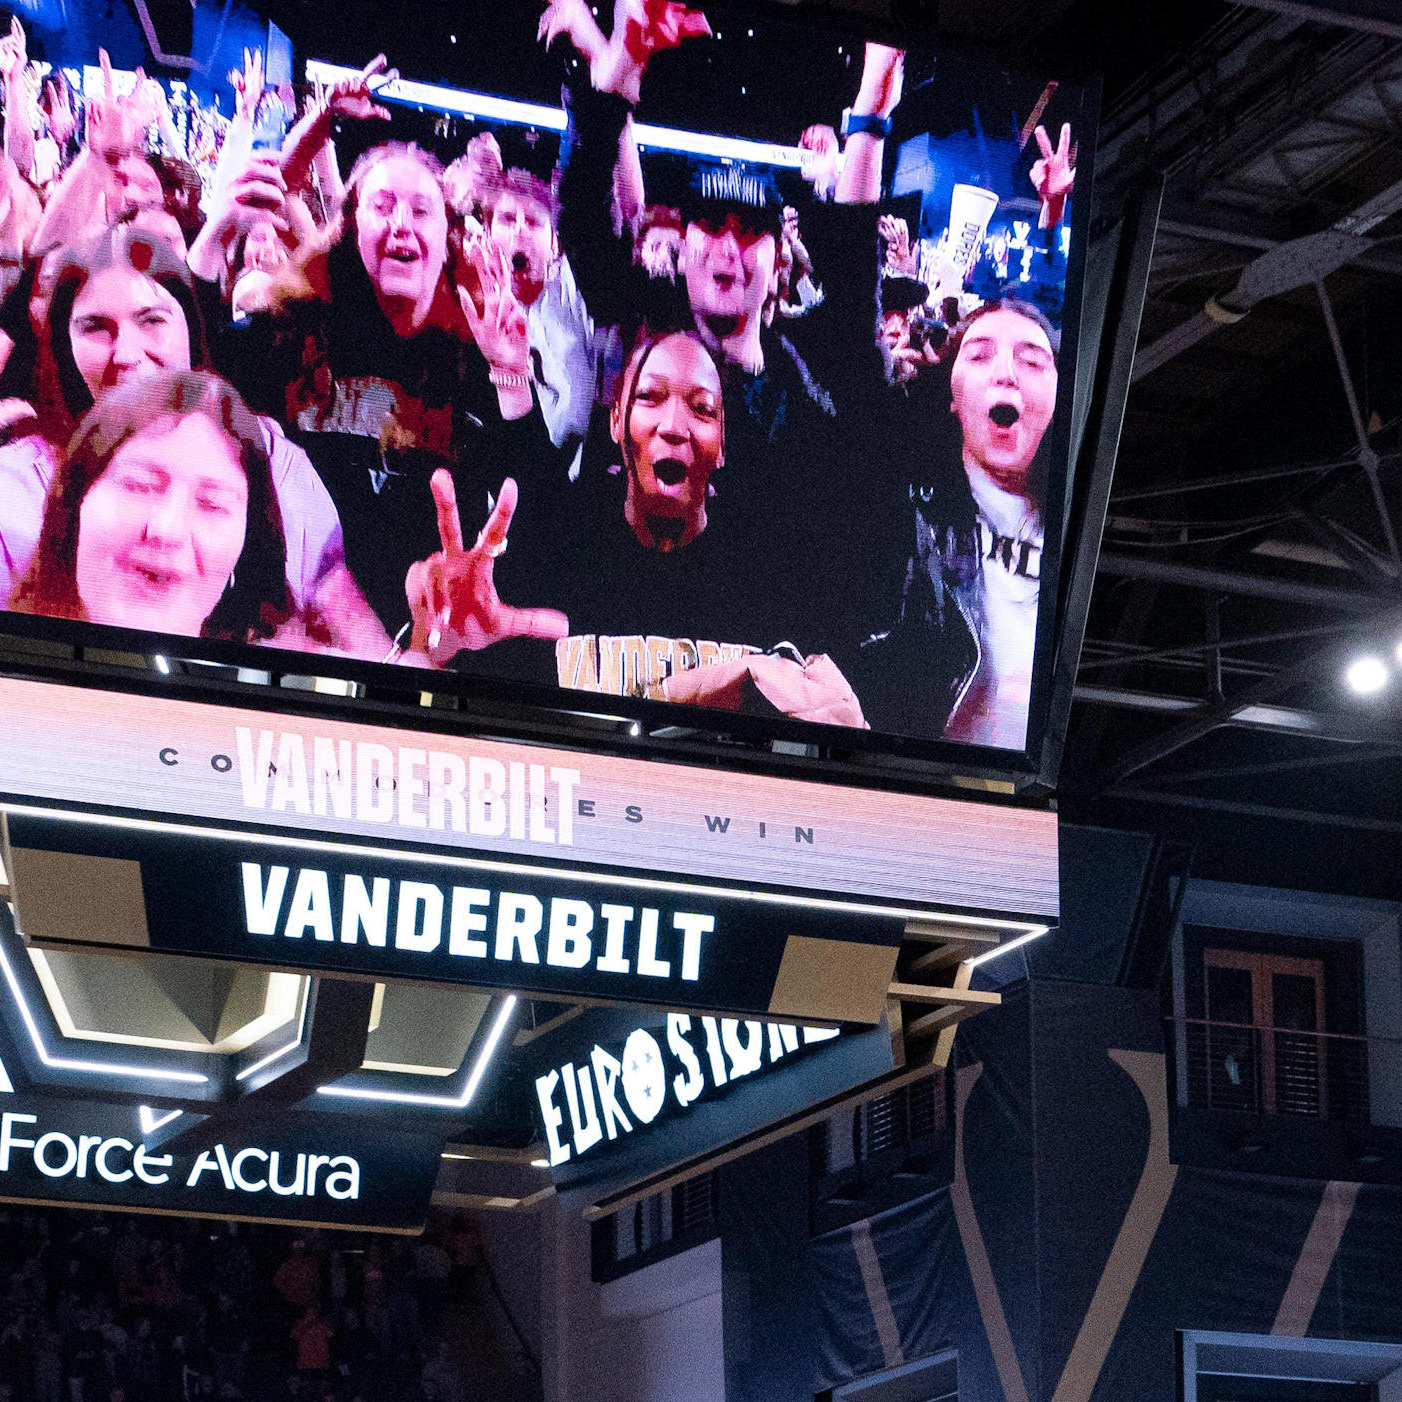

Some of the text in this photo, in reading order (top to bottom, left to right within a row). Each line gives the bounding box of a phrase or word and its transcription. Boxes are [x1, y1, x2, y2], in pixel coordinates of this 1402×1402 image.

[235, 726, 580, 847] VANDERBILT
[705, 814, 814, 844] WIN
[241, 862, 716, 982] VANDERBILT
[187, 1143, 360, 1200] Acura
